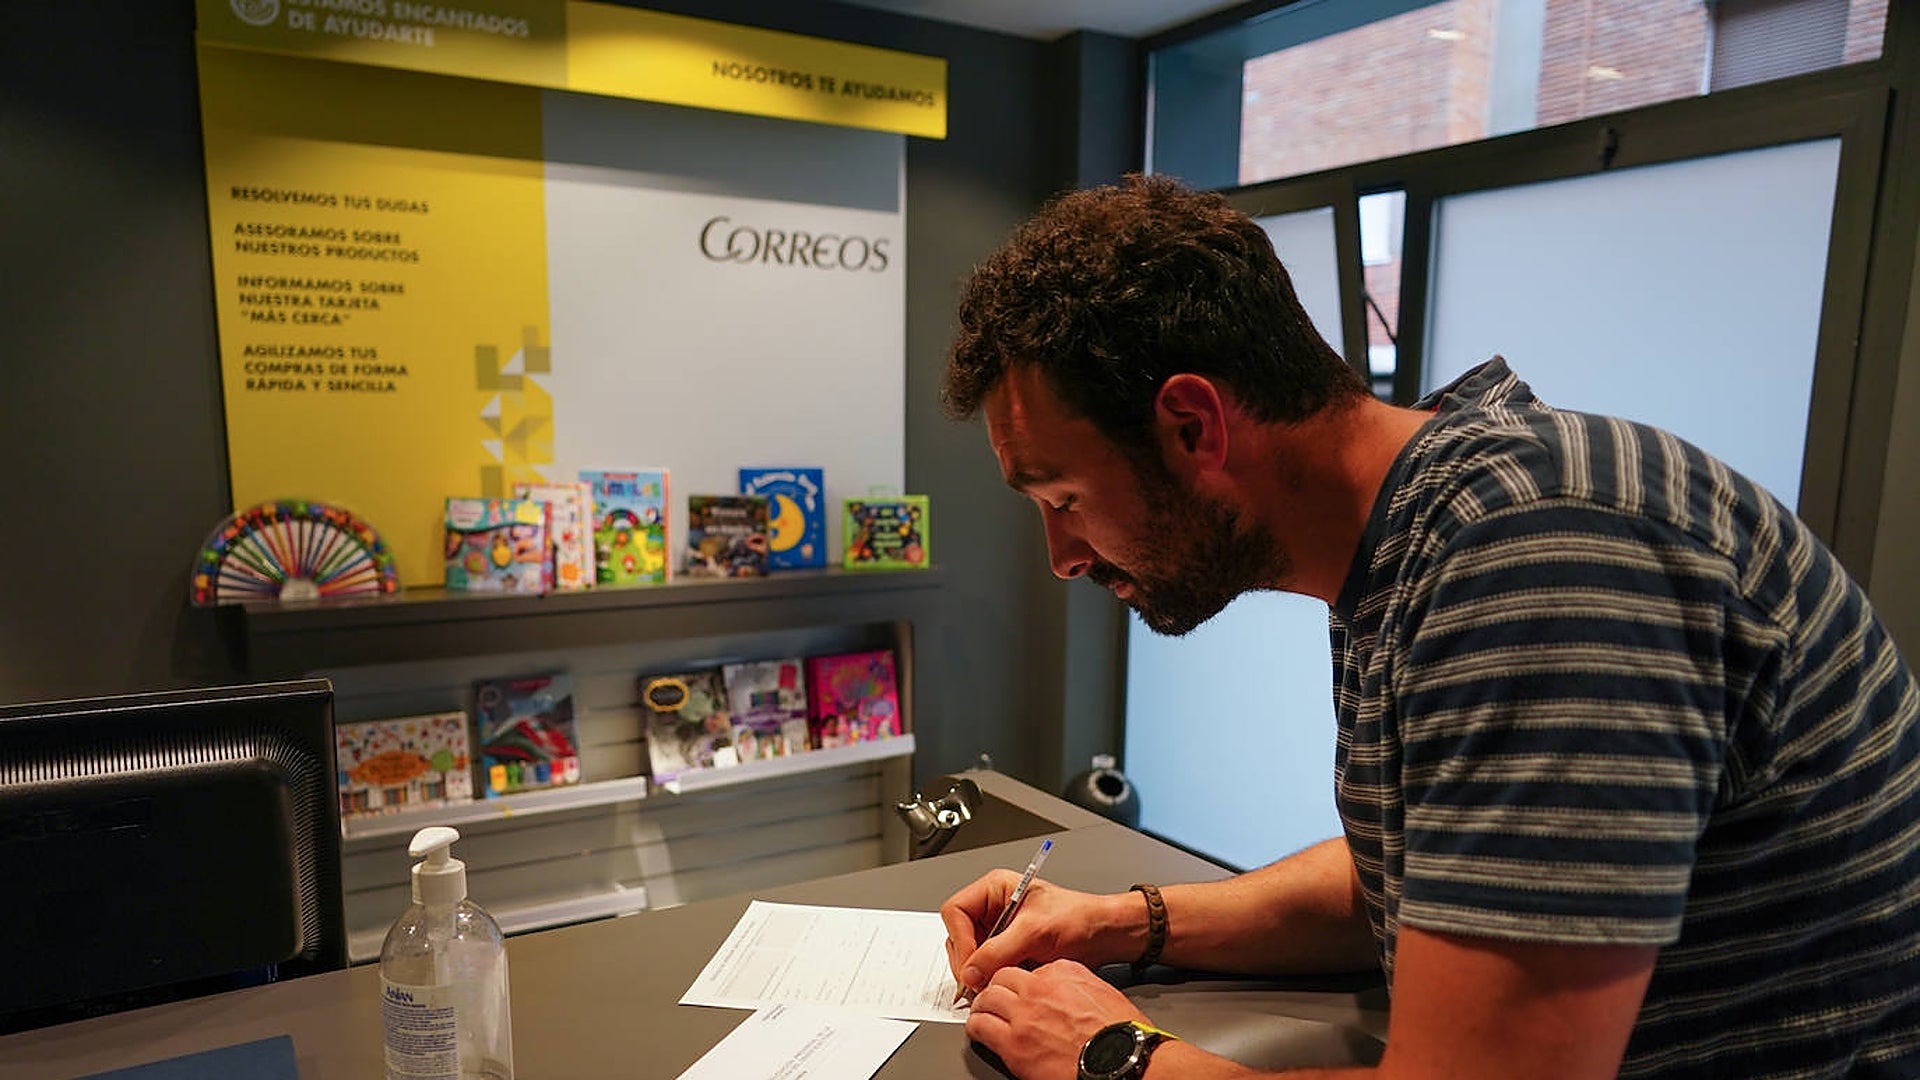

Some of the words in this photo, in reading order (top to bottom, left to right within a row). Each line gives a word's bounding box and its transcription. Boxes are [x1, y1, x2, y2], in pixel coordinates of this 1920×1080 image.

[288, 0, 387, 17] AMOS
[394, 3, 528, 37] ENCANTADOS
[288, 10, 316, 31] DE
[324, 15, 435, 47] AYUDARTE
[711, 60, 812, 91] NOSOTROS
[819, 76, 836, 95] TE
[841, 80, 935, 107] AYUDAMOS
[231, 186, 338, 206] RESOLVEMOS
[344, 195, 371, 210] TUS
[376, 198, 429, 213] DUDAS
[234, 222, 346, 241] ASESORAMOS
[352, 230, 400, 245] SOBRE
[699, 215, 890, 273] CORREOS
[235, 240, 320, 257] NUESTROS
[326, 245, 419, 263] PRODUCTOS
[238, 275, 352, 292] INFORMAMOS
[360, 281, 405, 295] SOBRE
[239, 293, 312, 308] NUESTRA
[319, 296, 380, 310] TARJETA
[243, 343, 344, 359] AGILIZAMOS
[351, 346, 377, 360] TUS
[244, 360, 324, 376] COMPRAS
[329, 362, 347, 376] DE
[354, 363, 408, 377] FORMA
[313, 380, 321, 391] Y
[327, 379, 396, 393] SENCILLA
